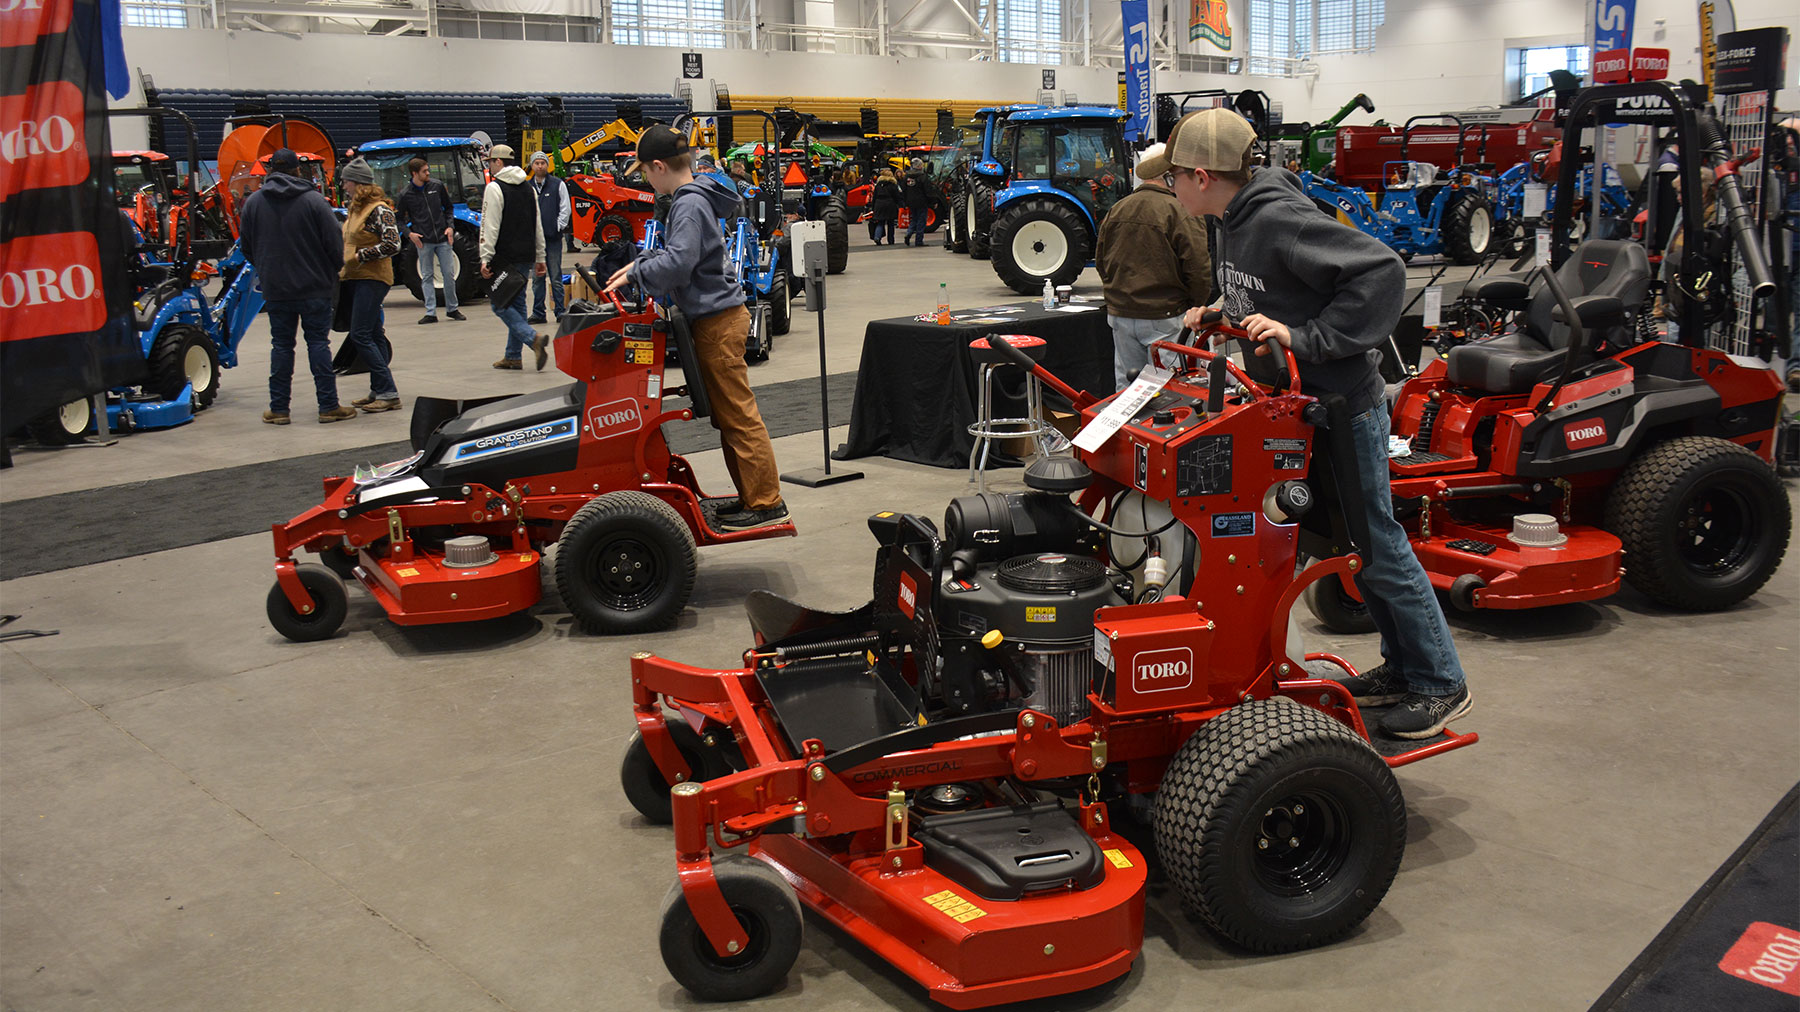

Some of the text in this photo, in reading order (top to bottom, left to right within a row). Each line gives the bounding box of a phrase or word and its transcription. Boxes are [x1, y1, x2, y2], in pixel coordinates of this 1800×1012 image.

[1596, 59, 1625, 73] TORO
[1635, 57, 1667, 69] TORO
[1646, 108, 1674, 116] COMPRO
[584, 130, 606, 146] JCB
[0, 264, 95, 308] ORO
[594, 408, 636, 428] TORO
[1567, 425, 1602, 442] TORO
[900, 582, 915, 609] TORO
[1137, 661, 1187, 681] TORO
[853, 761, 962, 784] COMMERCIAL
